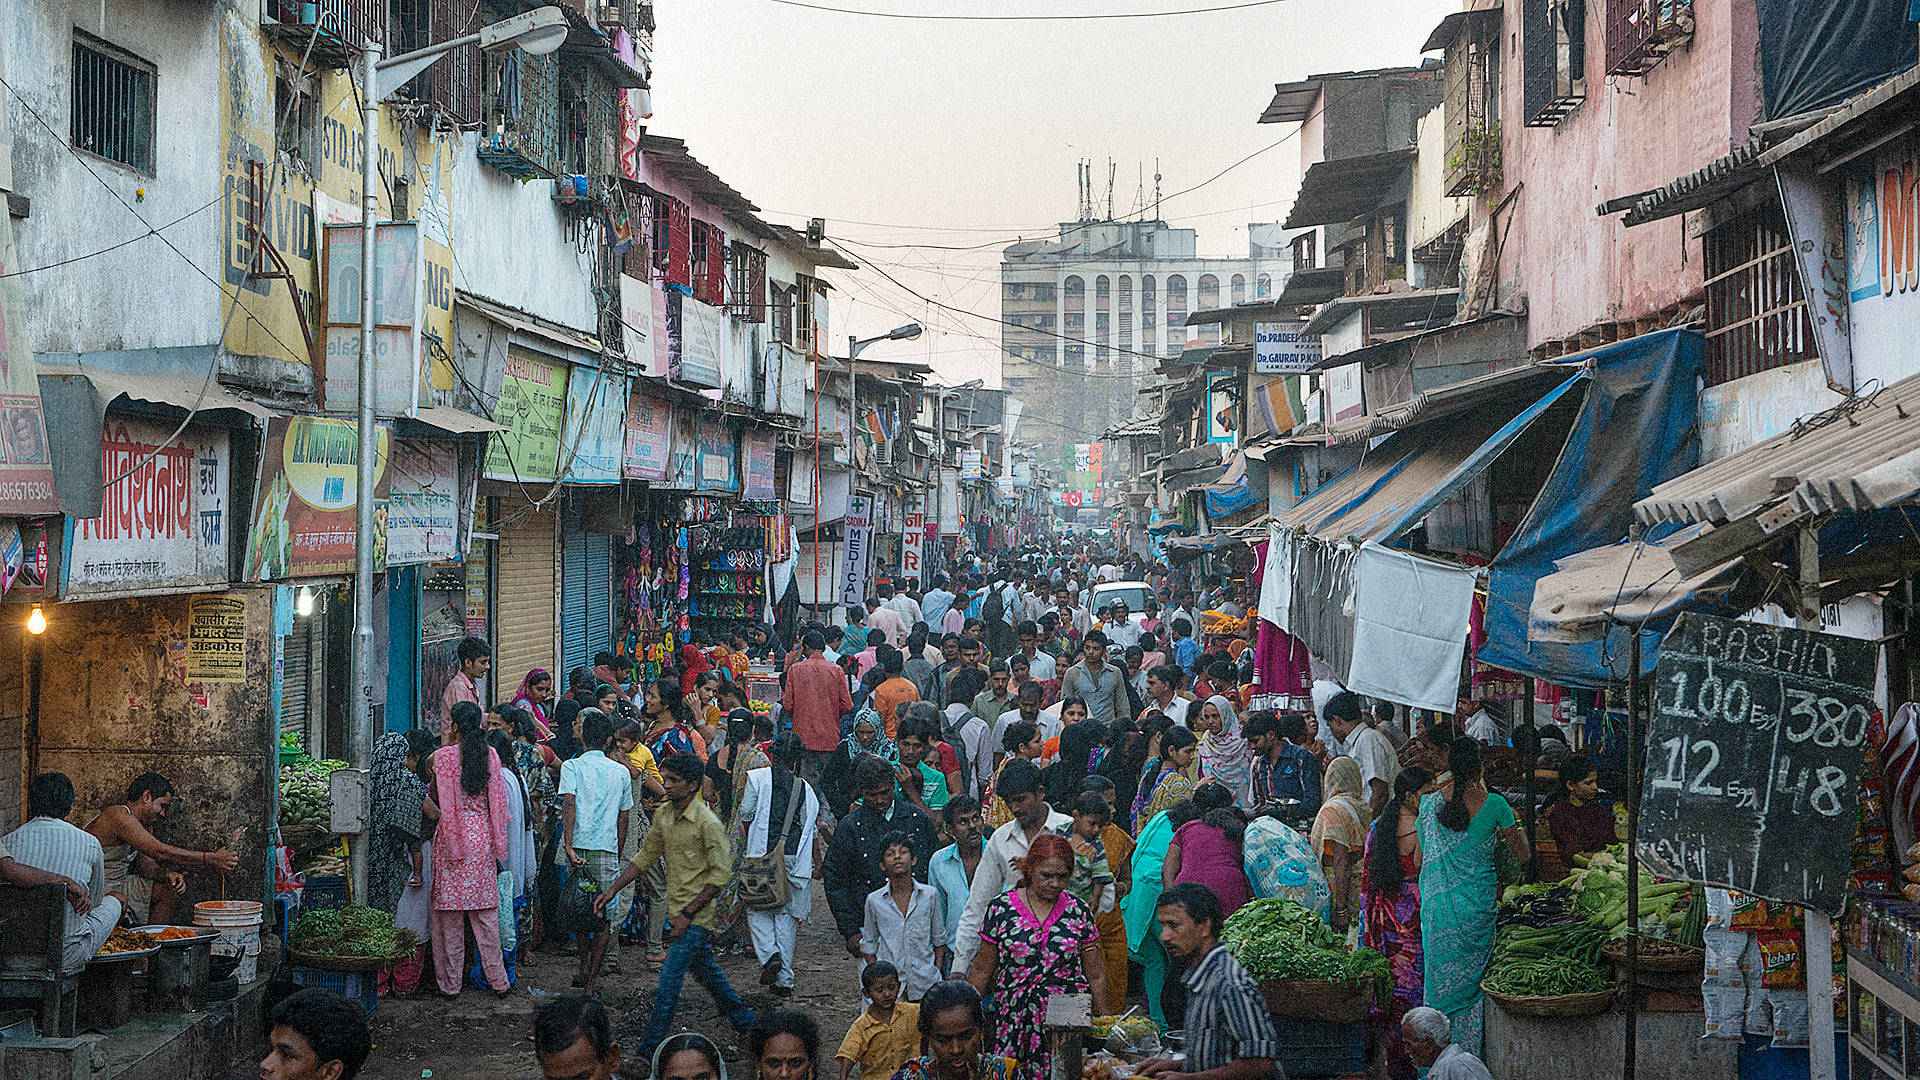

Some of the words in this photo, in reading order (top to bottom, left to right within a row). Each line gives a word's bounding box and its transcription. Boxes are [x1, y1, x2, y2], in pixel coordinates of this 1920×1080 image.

[531, 361, 553, 387] CLINIC
[0, 480, 53, 501] 86676384
[38, 541, 46, 575] BINNY
[844, 528, 861, 605] MEDICAL
[903, 512, 923, 586] नागरि
[1659, 670, 1751, 725] 100
[1785, 687, 1872, 748] 380
[1651, 736, 1723, 796] 12
[1776, 755, 1848, 817] 48
